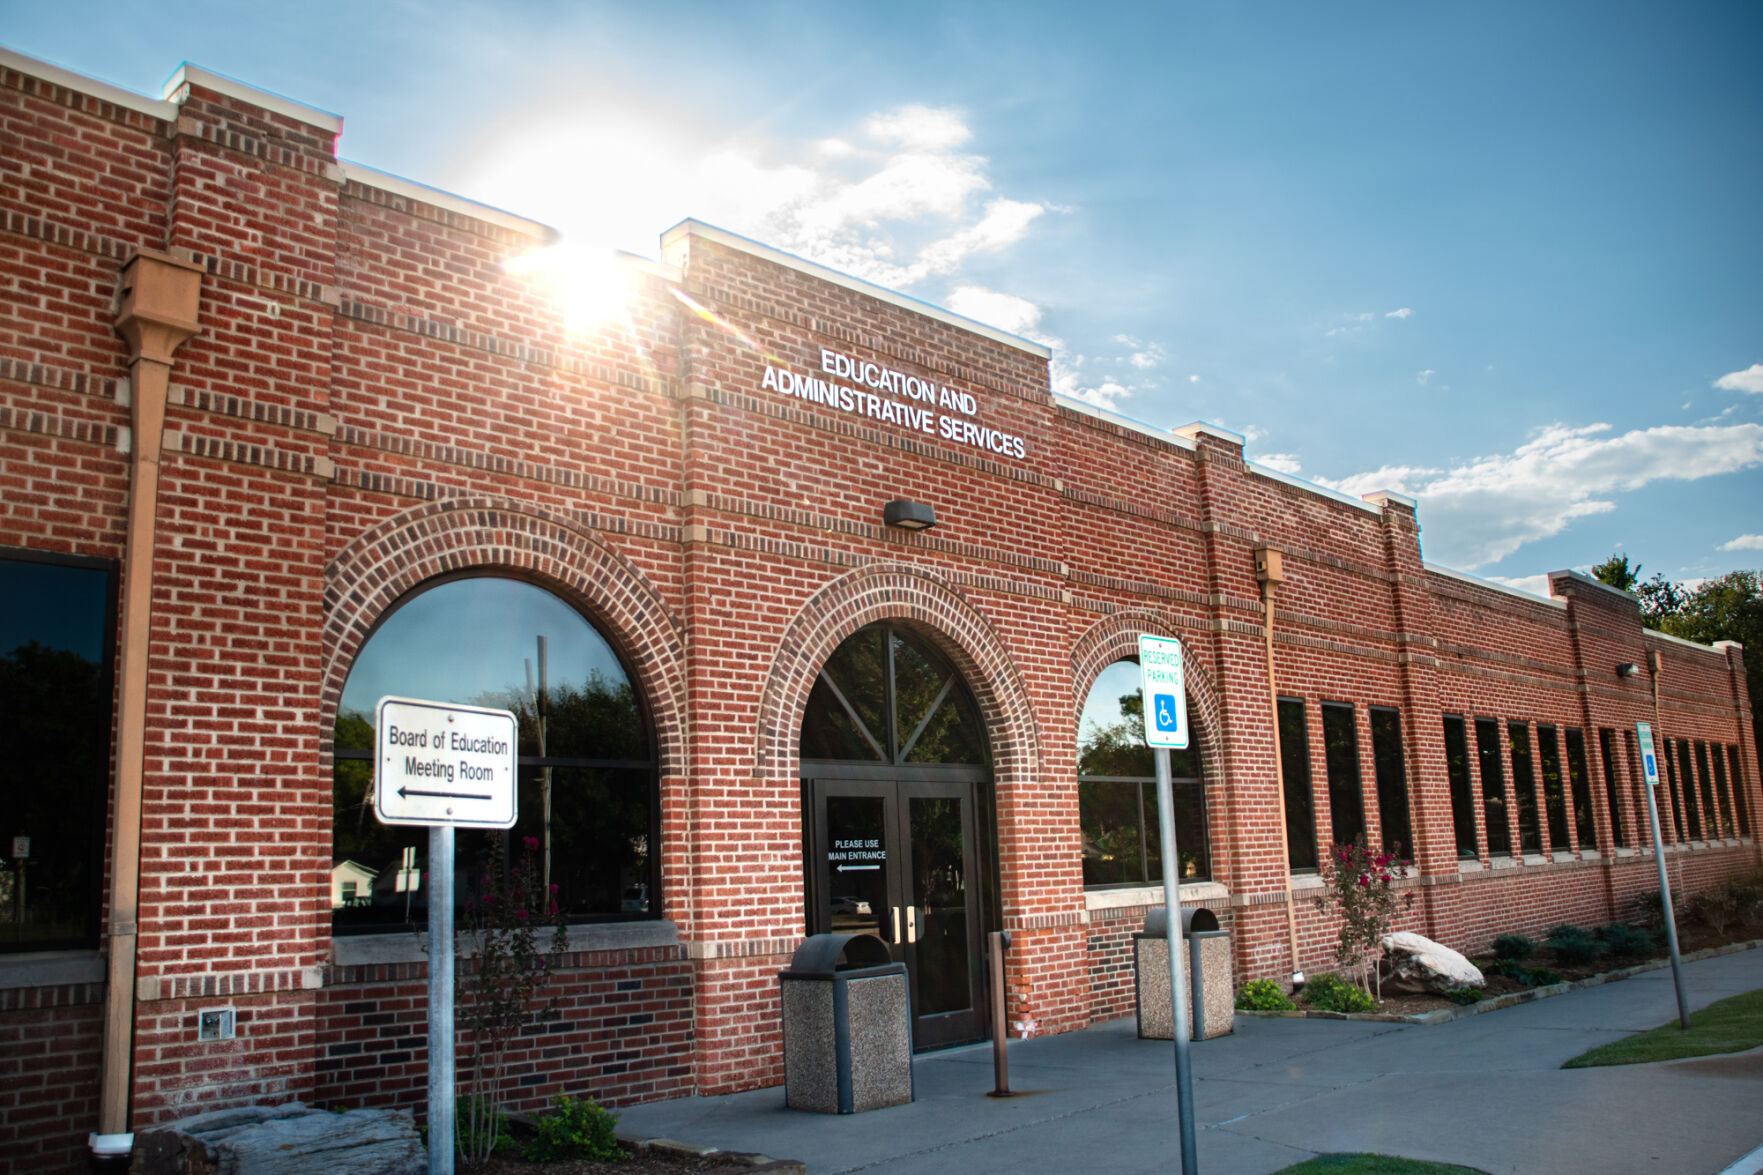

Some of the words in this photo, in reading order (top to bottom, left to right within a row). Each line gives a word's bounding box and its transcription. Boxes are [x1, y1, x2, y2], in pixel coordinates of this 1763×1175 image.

[821, 349, 935, 405] EDUCATION
[939, 386, 977, 417] AND
[761, 365, 935, 434] ADMINISTRATIVE
[939, 414, 1026, 460] SERVICES
[1143, 649, 1179, 667] RESERVED
[1147, 668, 1179, 685] PARKING
[389, 725, 427, 748] Board
[433, 731, 446, 750] of
[451, 732, 508, 755] Education
[405, 756, 454, 783] Meeting
[460, 761, 494, 781] Room
[828, 851, 847, 860] MAIN
[848, 850, 887, 860] ENTRANCE
[835, 839, 864, 849] PLEASE
[864, 839, 880, 848] USE
